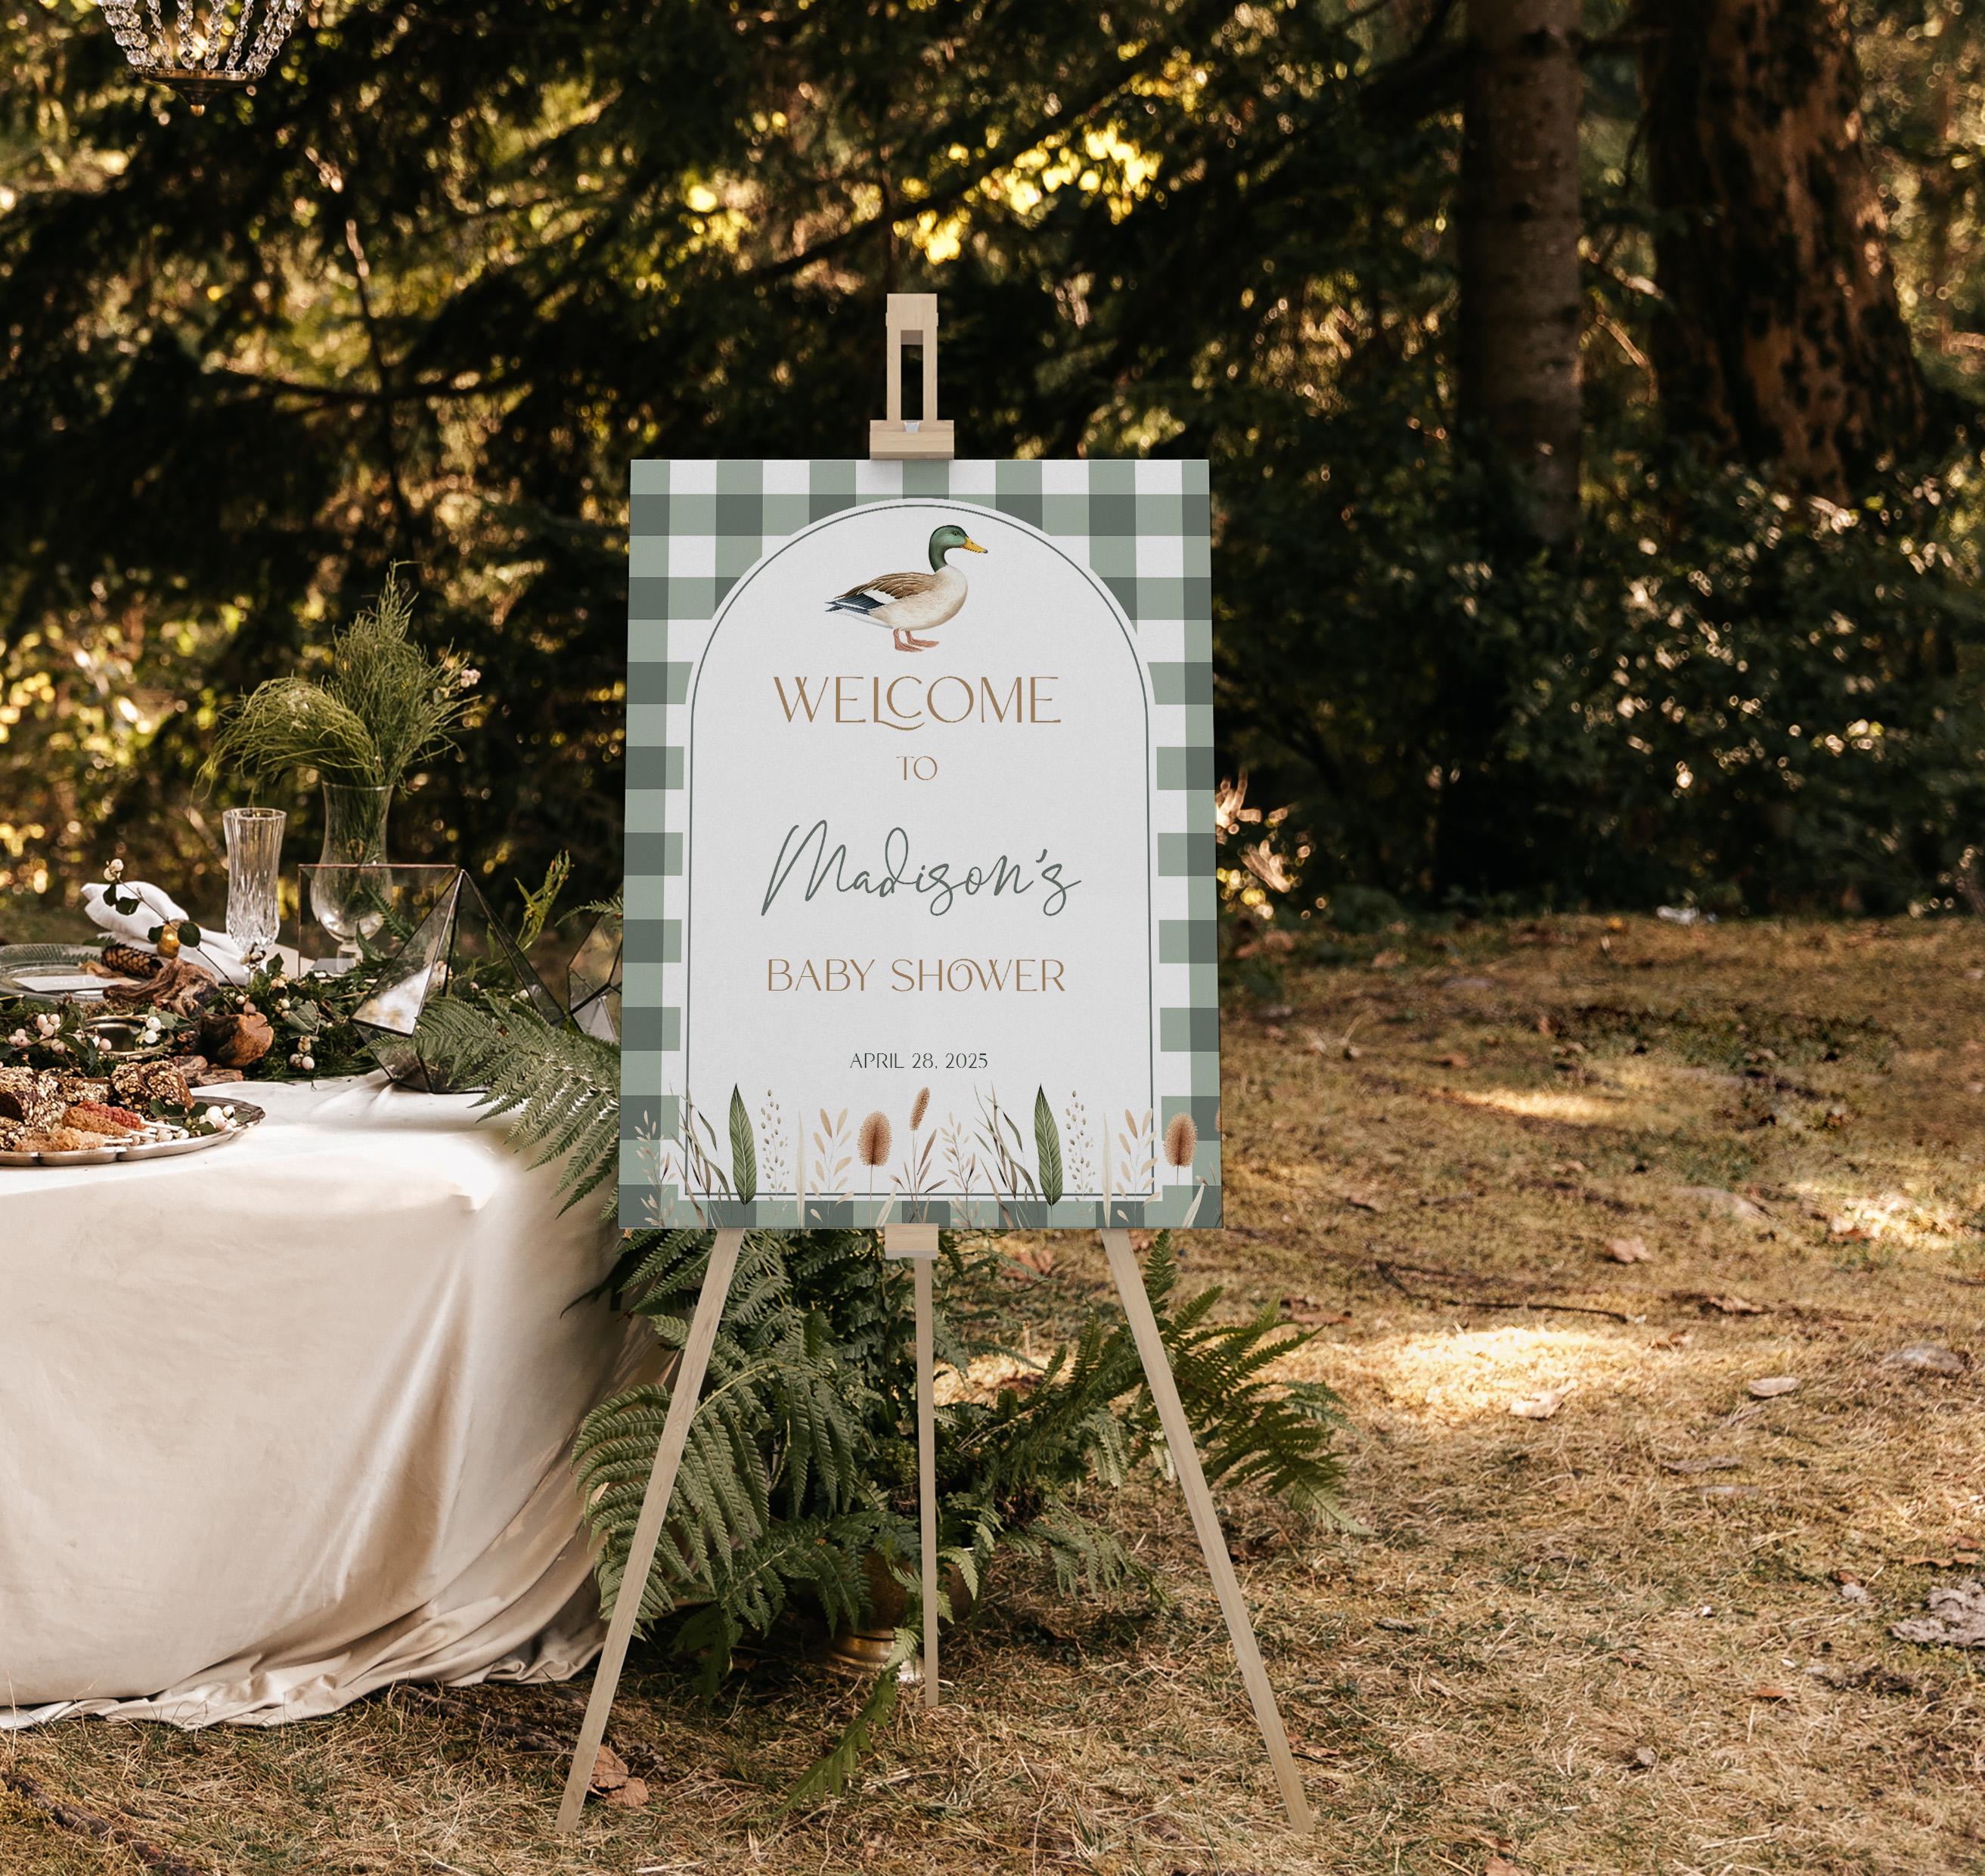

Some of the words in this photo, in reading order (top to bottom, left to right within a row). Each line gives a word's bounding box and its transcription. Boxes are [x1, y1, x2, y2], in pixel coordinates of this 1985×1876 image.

[773, 675, 1062, 731] WELCOME
[895, 755, 938, 781] TO
[761, 819, 1082, 916] Madison's
[768, 959, 876, 991] BABY
[891, 958, 1065, 993] SHOWER
[849, 1053, 905, 1069] APRIL
[912, 1053, 938, 1070] 28,
[944, 1053, 988, 1069] 2025
